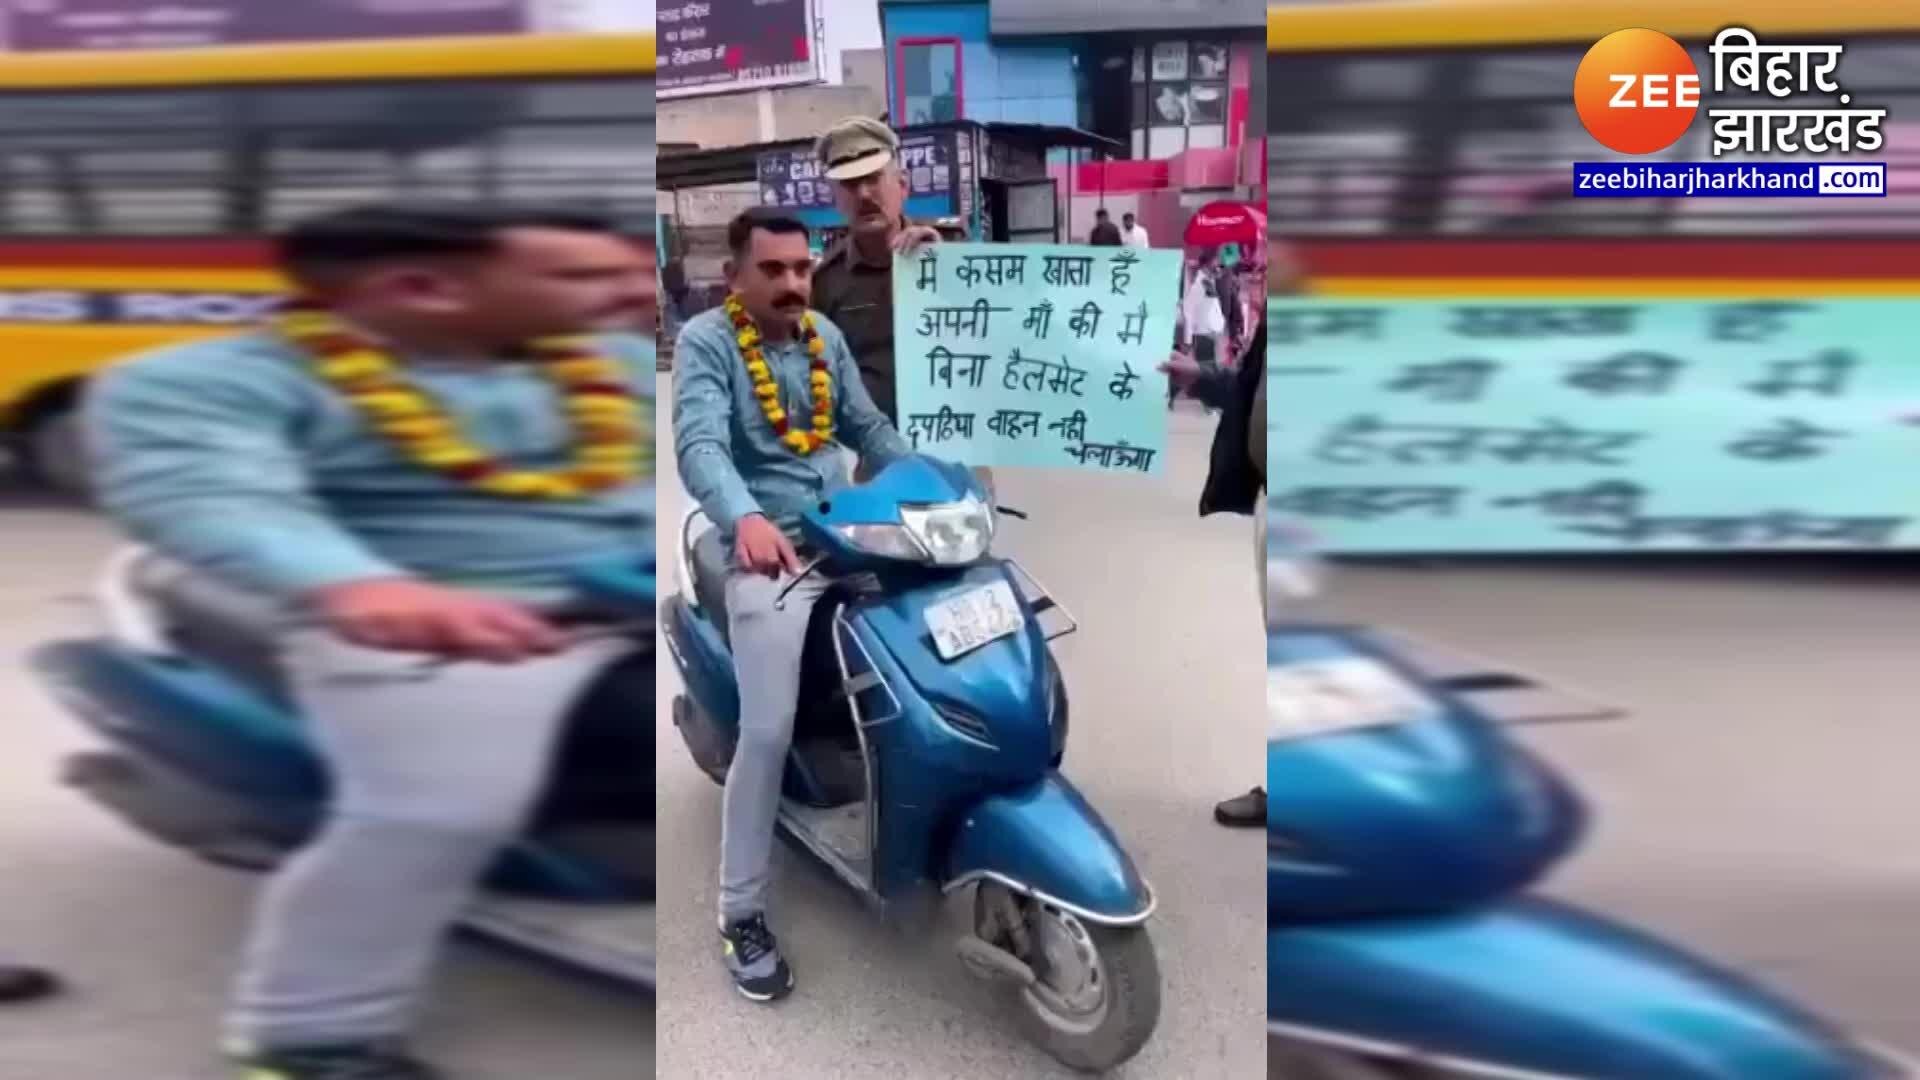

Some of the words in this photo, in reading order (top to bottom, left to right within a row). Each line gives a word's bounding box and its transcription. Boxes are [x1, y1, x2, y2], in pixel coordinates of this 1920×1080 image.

[956, 255, 1028, 288] कसम
[1042, 256, 1096, 286] खाता
[916, 298, 1013, 338] अपनी
[1022, 299, 1053, 339] माँ
[1069, 301, 1103, 339] की
[926, 346, 991, 388] बिना
[1109, 361, 1141, 401] के
[987, 409, 1041, 439] वाहन
